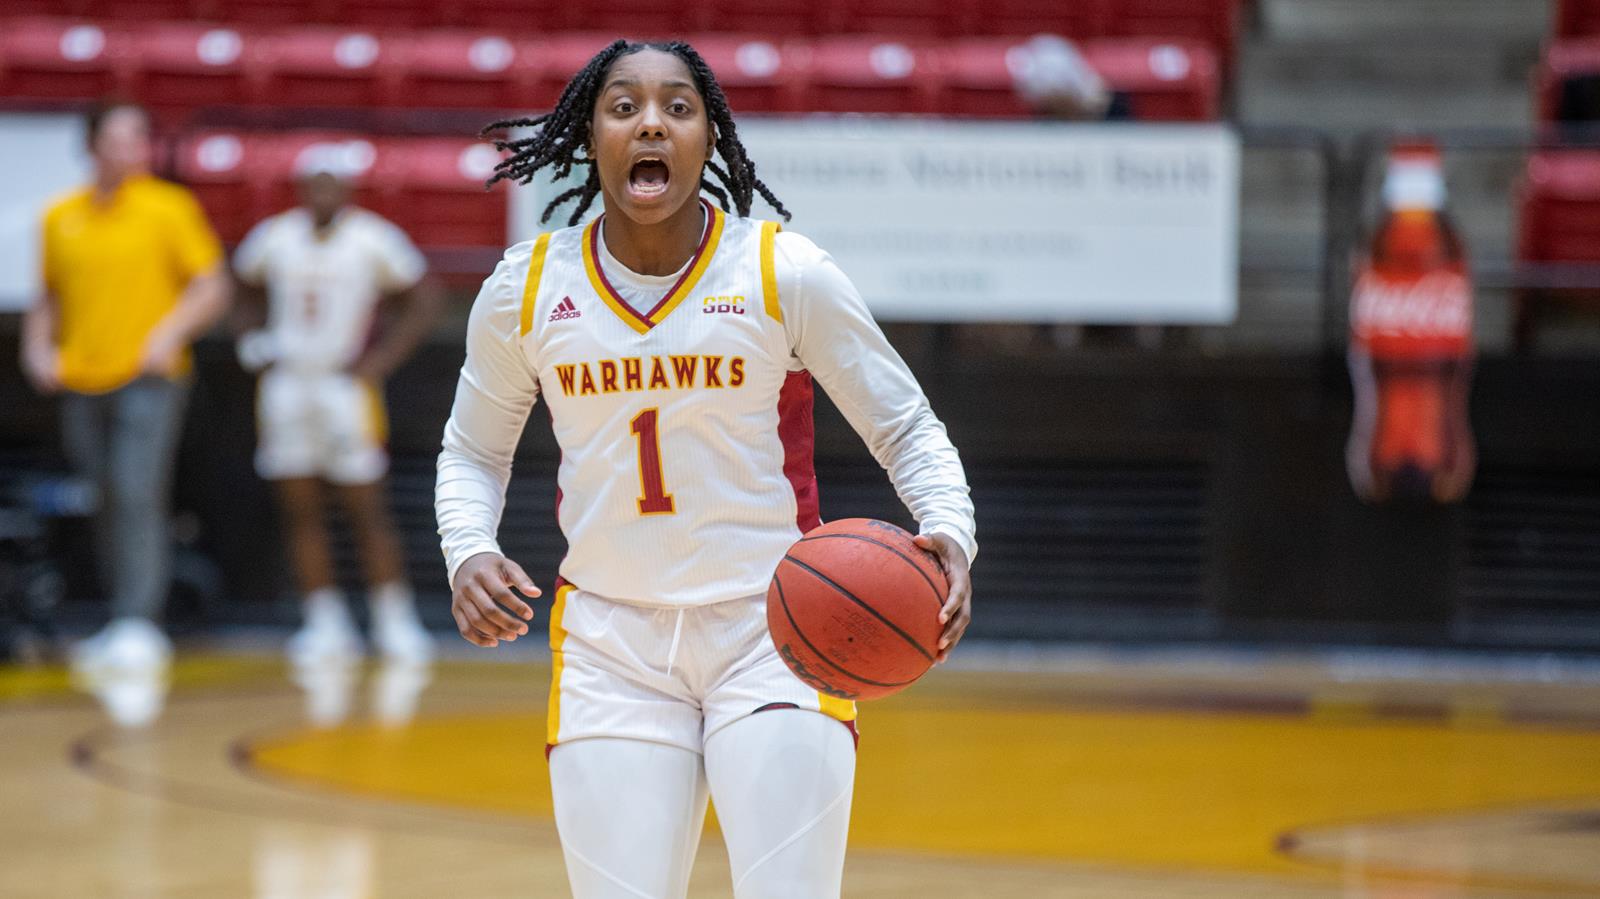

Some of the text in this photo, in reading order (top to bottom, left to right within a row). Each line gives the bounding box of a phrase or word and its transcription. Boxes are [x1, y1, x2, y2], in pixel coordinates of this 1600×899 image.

[548, 308, 581, 322] adidas
[702, 295, 745, 315] SBC
[554, 355, 746, 397] WARHAWKS
[629, 406, 677, 516] 1
